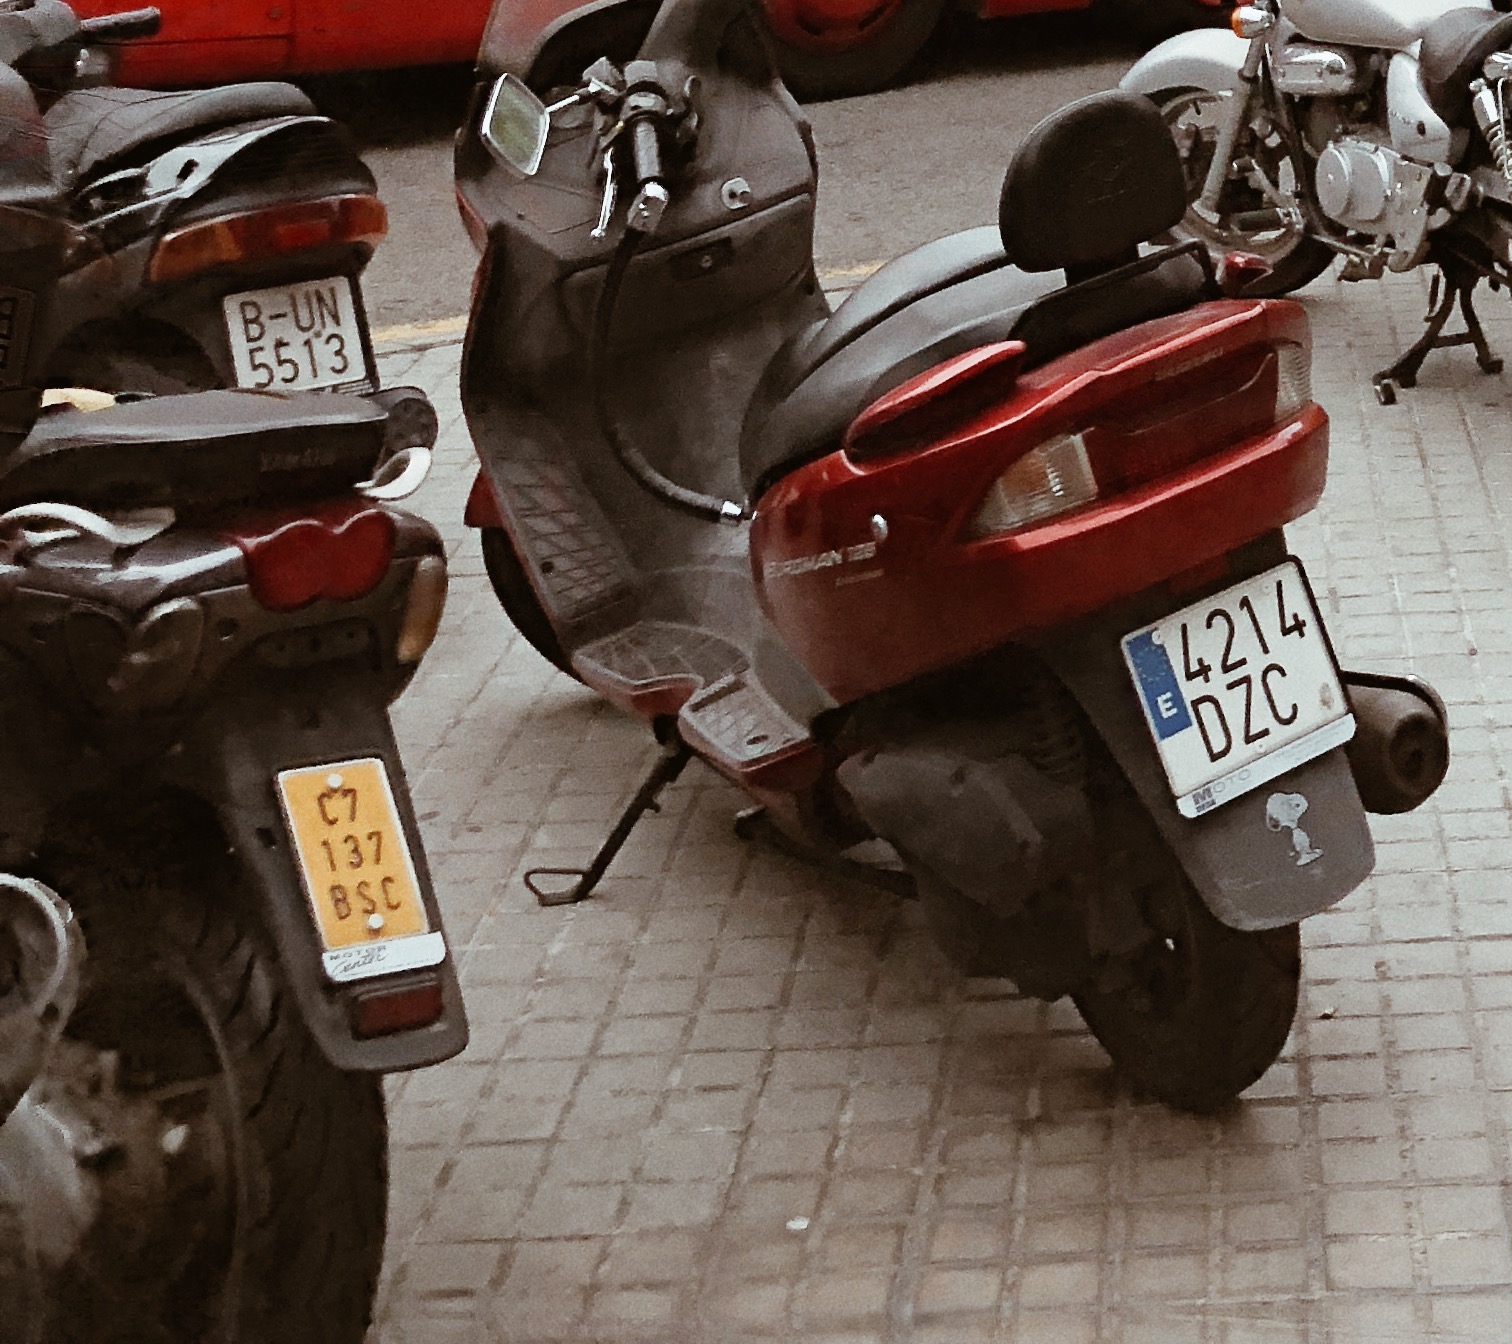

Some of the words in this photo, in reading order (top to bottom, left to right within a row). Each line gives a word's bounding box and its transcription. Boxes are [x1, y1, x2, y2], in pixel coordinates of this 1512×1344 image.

[239, 286, 341, 344] B-UN
[248, 333, 349, 389] 5513
[1180, 579, 1307, 684] 4214
[1155, 691, 1178, 720] E
[1189, 662, 1299, 763] DZC
[317, 786, 359, 826] C7
[1192, 768, 1252, 805] MOTO
[320, 830, 383, 872] 137
[328, 875, 402, 921] BSC
